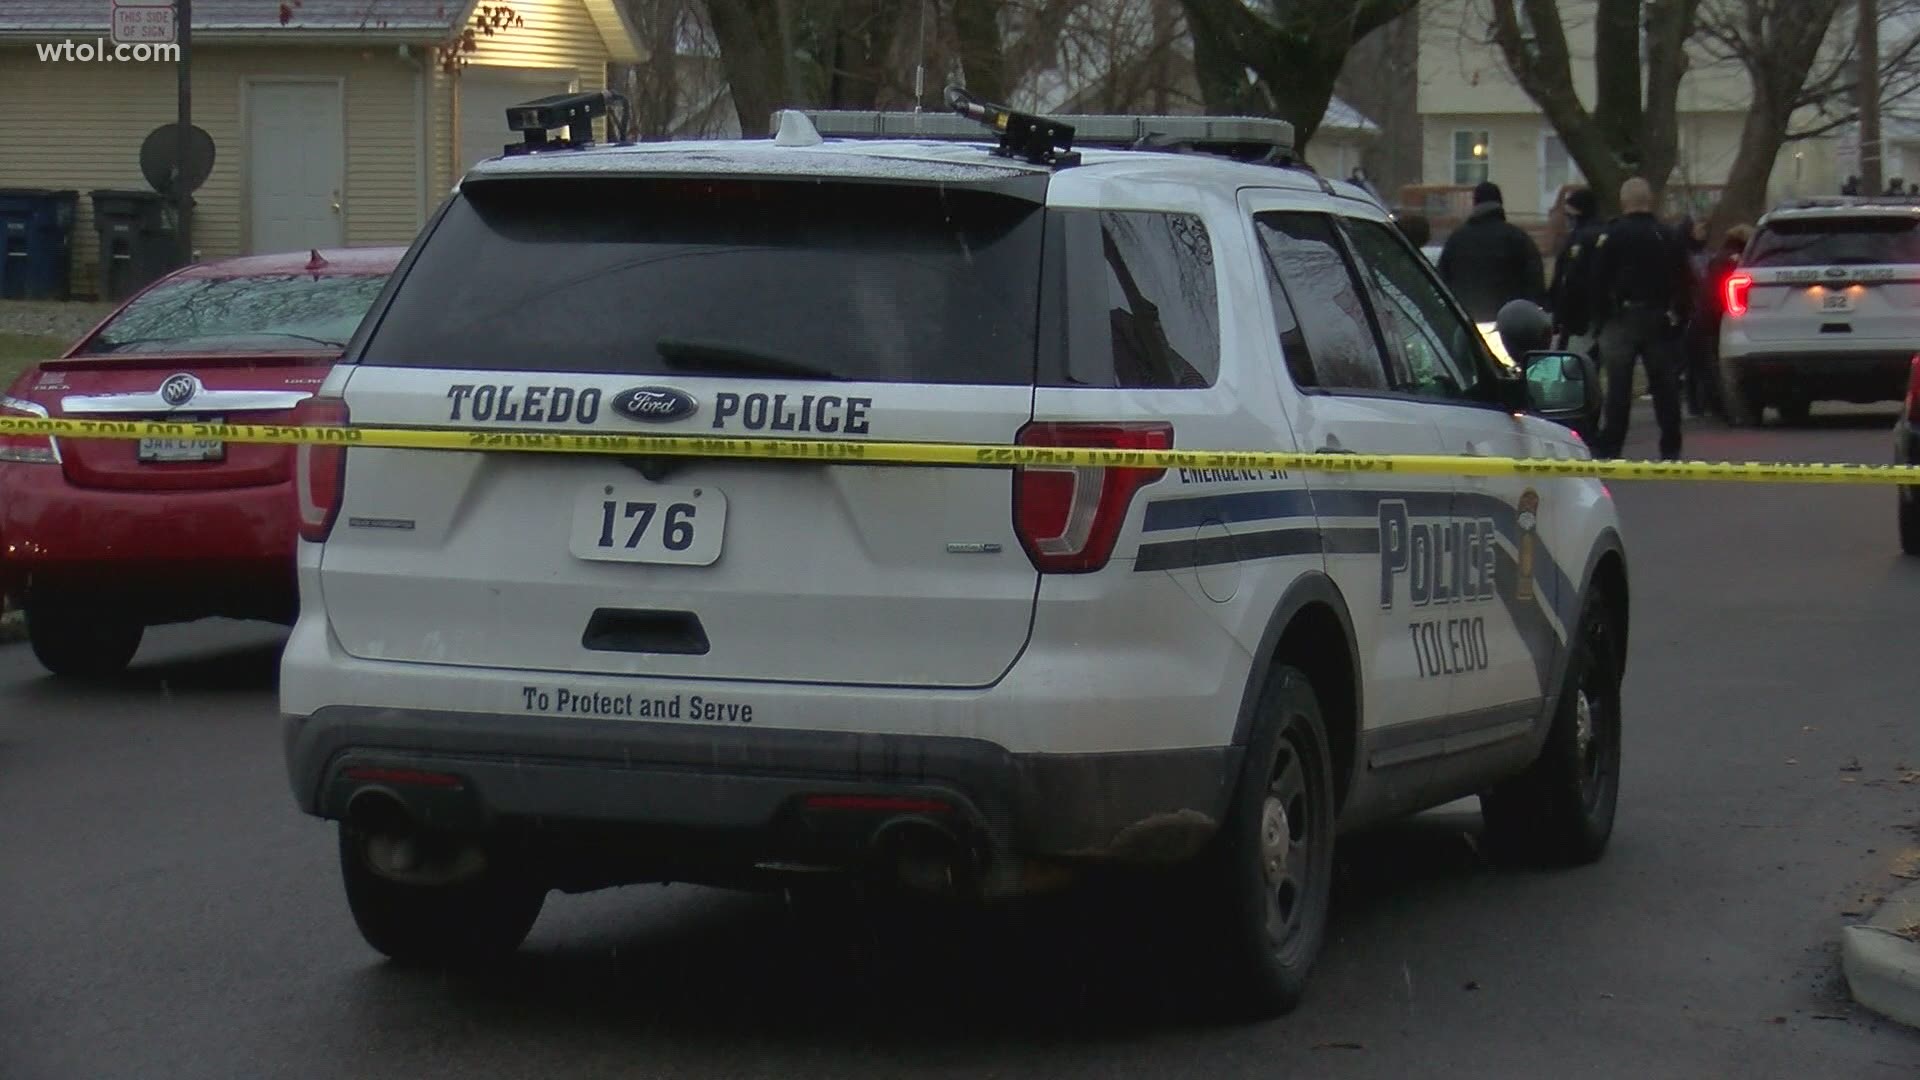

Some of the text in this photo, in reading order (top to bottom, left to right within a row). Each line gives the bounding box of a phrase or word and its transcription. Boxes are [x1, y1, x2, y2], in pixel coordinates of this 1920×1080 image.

[120, 11, 169, 23] THIS SIDE
[123, 25, 166, 38] OF SIGN
[447, 384, 872, 434] TOLEDO Ford POLICE
[598, 501, 697, 551] 176
[1379, 499, 1496, 609] POLICE
[1409, 616, 1489, 678] TOLEDO
[523, 686, 753, 722] To Protect and Serve
